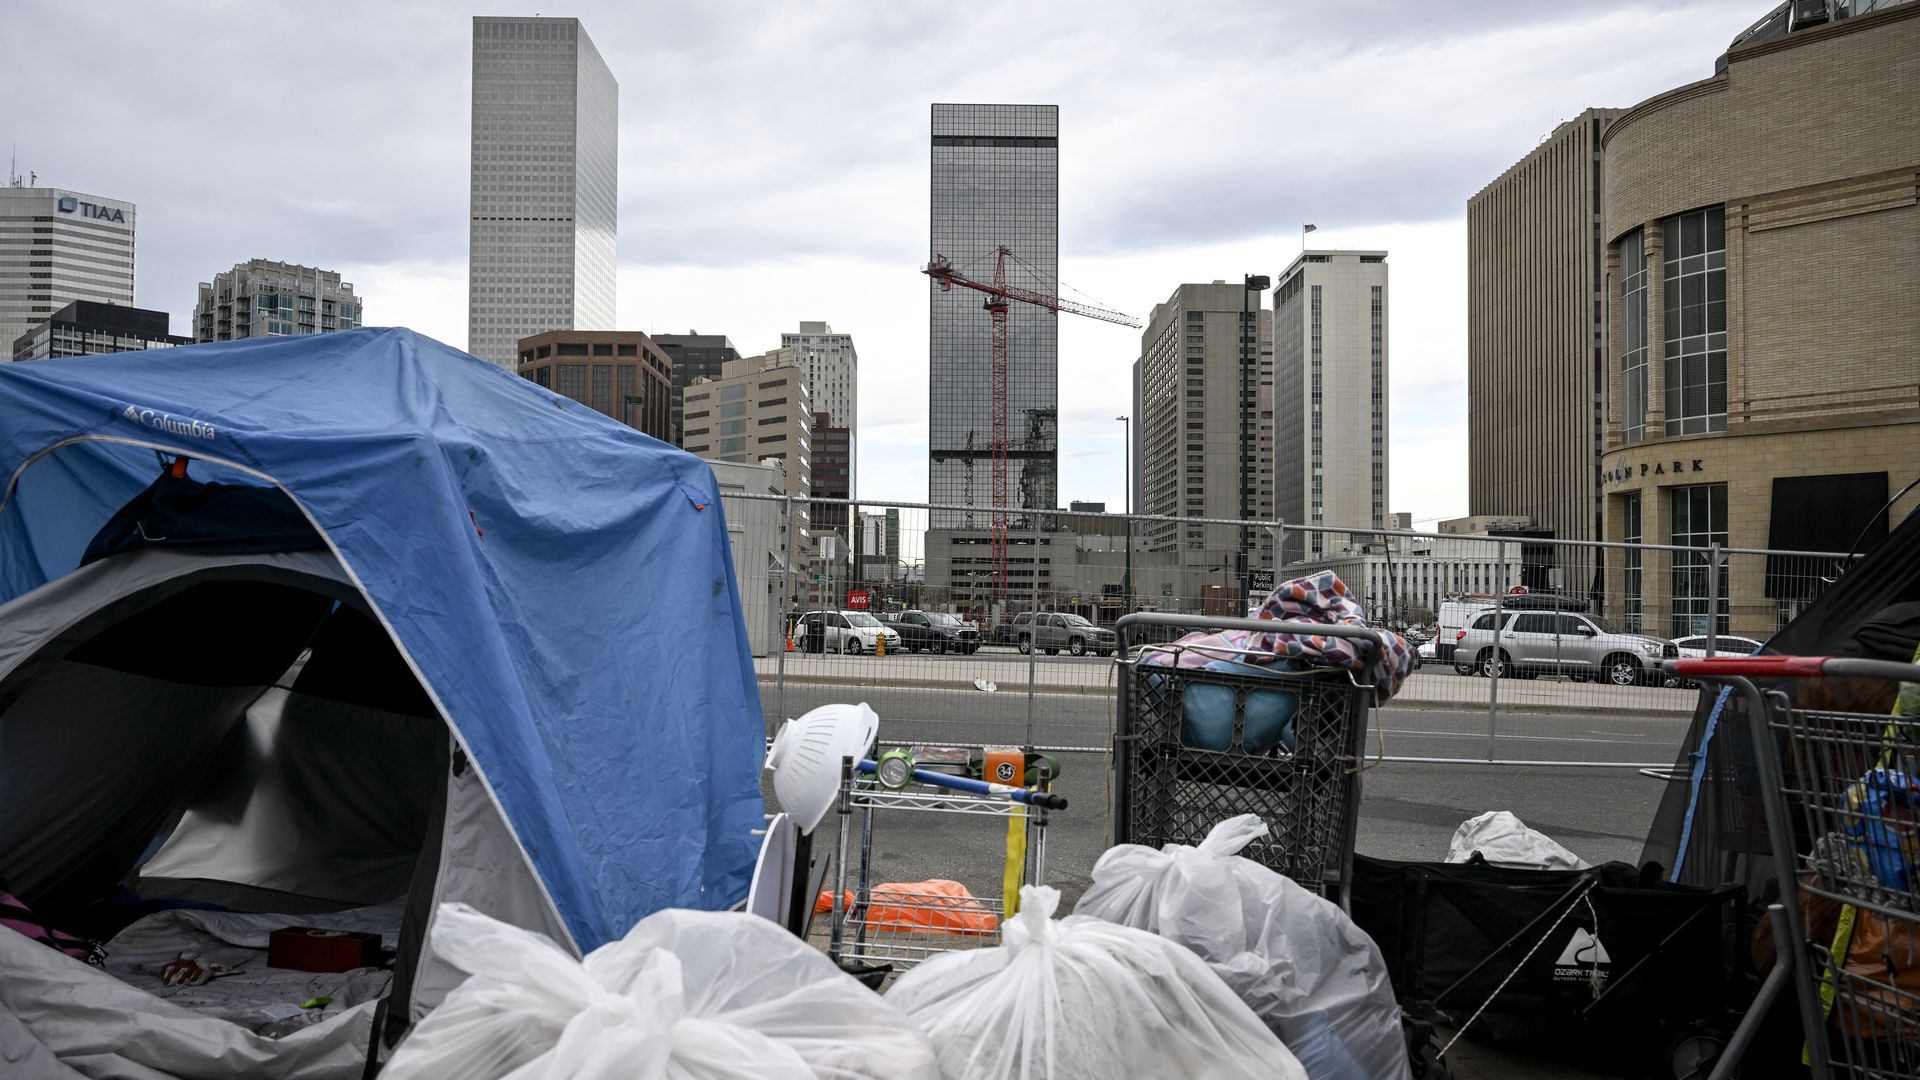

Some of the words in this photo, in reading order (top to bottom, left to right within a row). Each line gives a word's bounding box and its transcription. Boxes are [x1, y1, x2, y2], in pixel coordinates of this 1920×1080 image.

[79, 201, 126, 224] TIAA
[140, 410, 215, 440] Columbia
[1640, 459, 1703, 477] PARK
[1254, 572, 1272, 582] Public
[1252, 580, 1274, 591] Parking
[850, 596, 867, 604] AVIS
